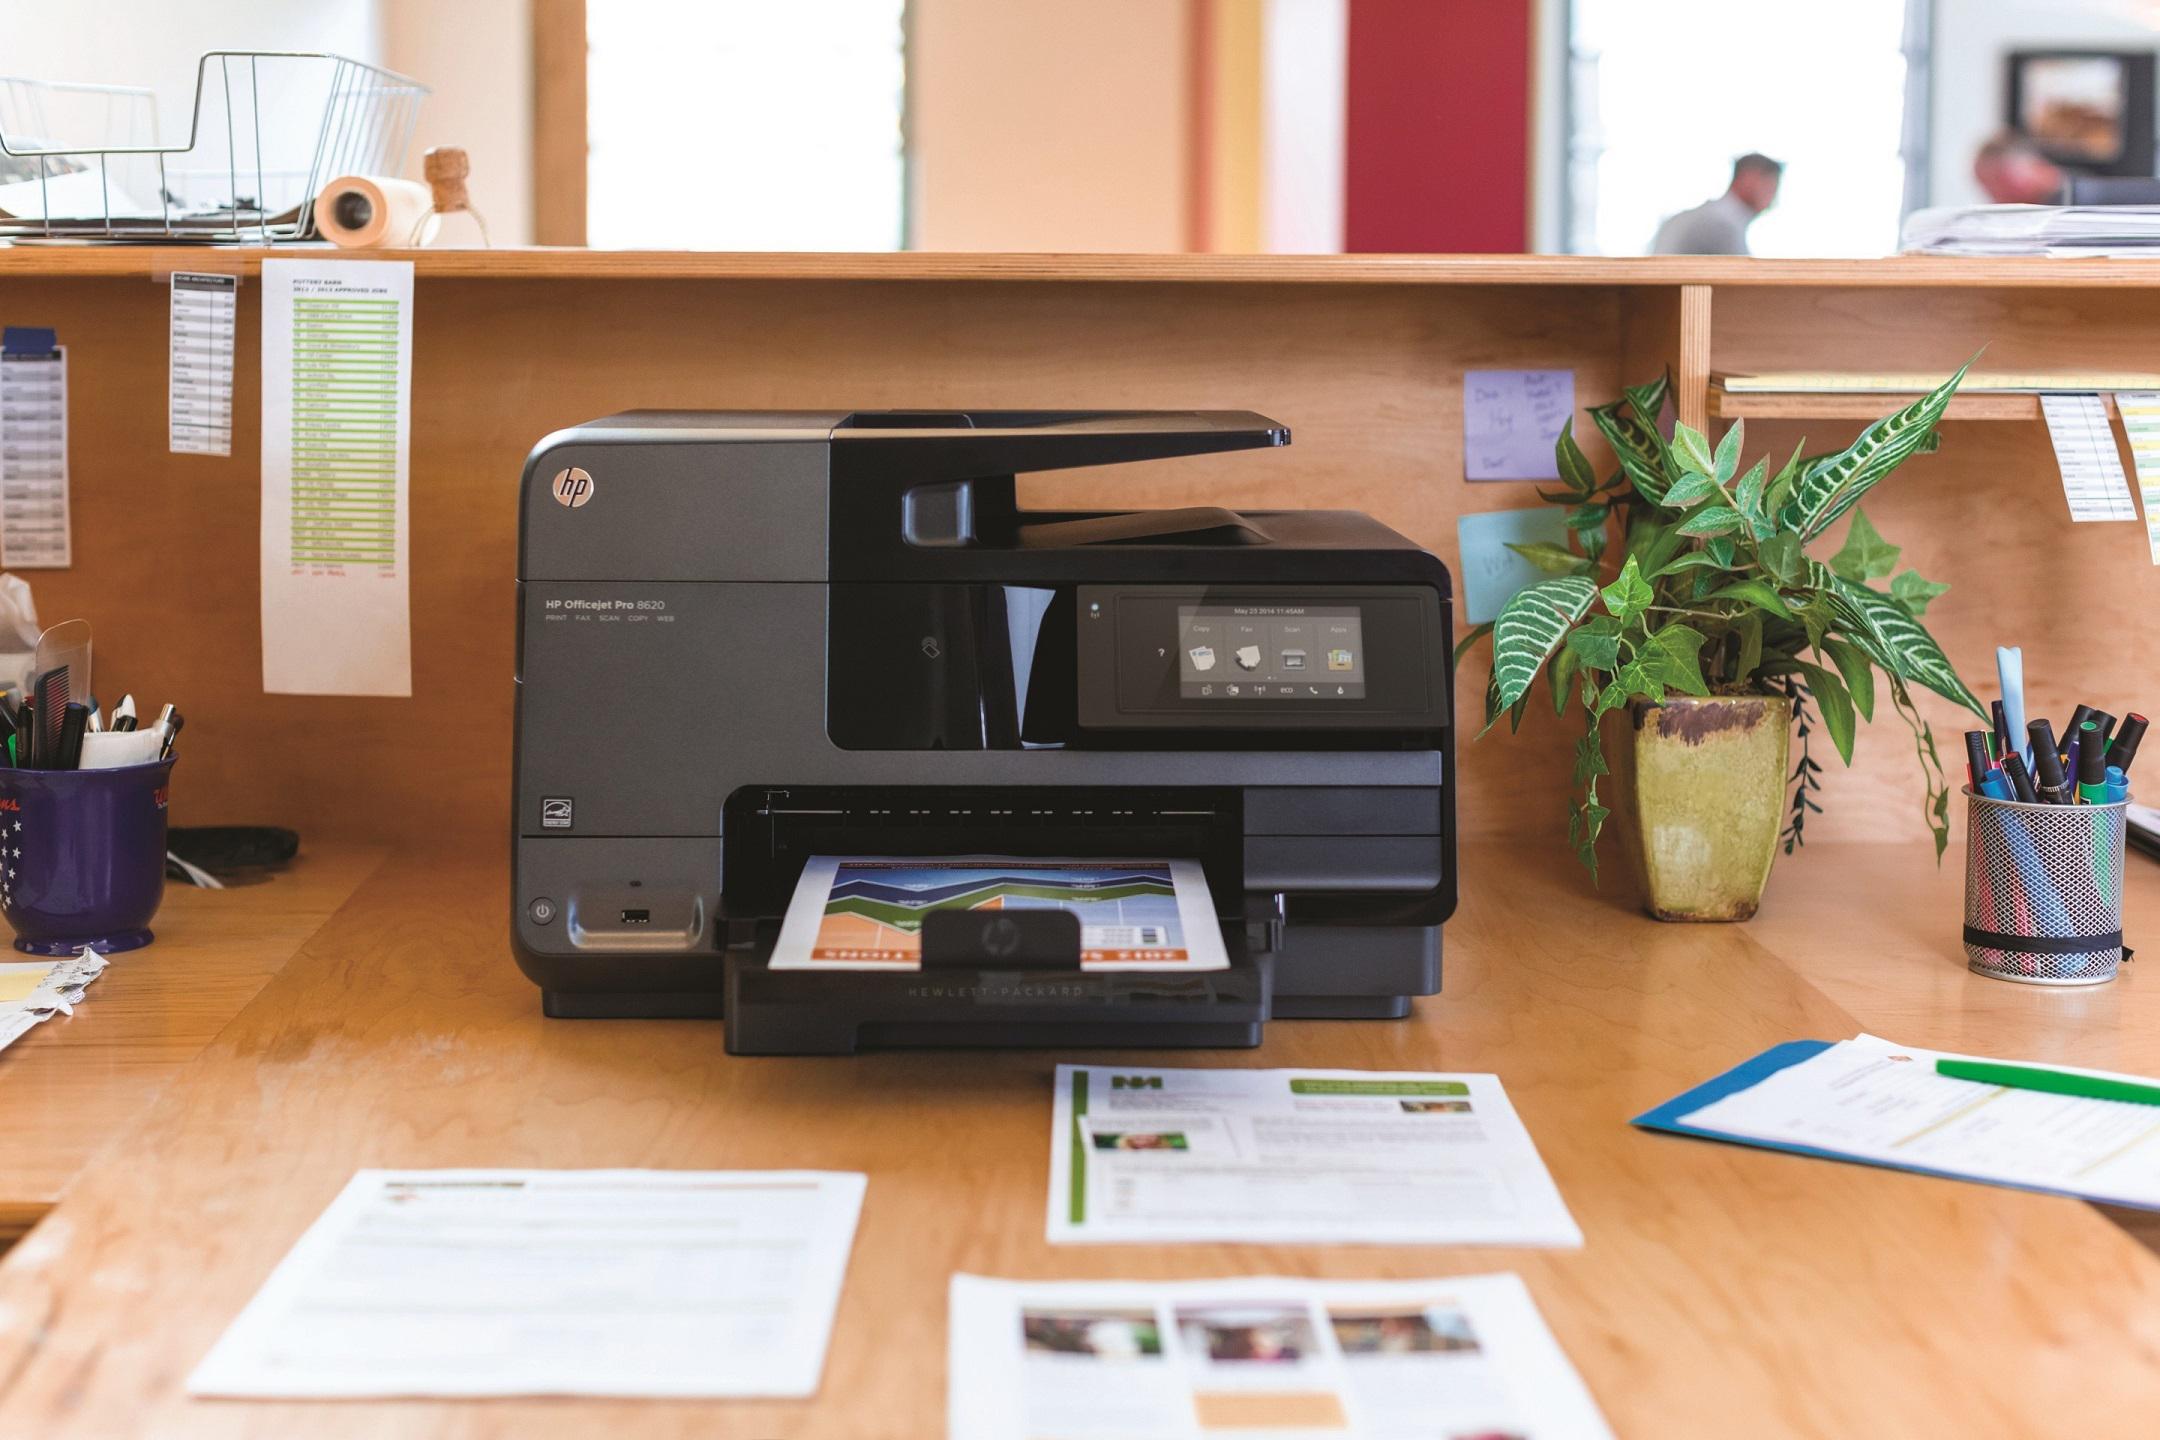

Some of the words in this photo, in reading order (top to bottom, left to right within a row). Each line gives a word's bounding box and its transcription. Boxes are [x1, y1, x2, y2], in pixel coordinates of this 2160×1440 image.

[557, 467, 590, 507] hp
[545, 600, 562, 609] HP
[564, 600, 612, 611] Officejet
[615, 600, 634, 609] Pro
[636, 600, 666, 610] 8620
[1193, 625, 1210, 633] Copy
